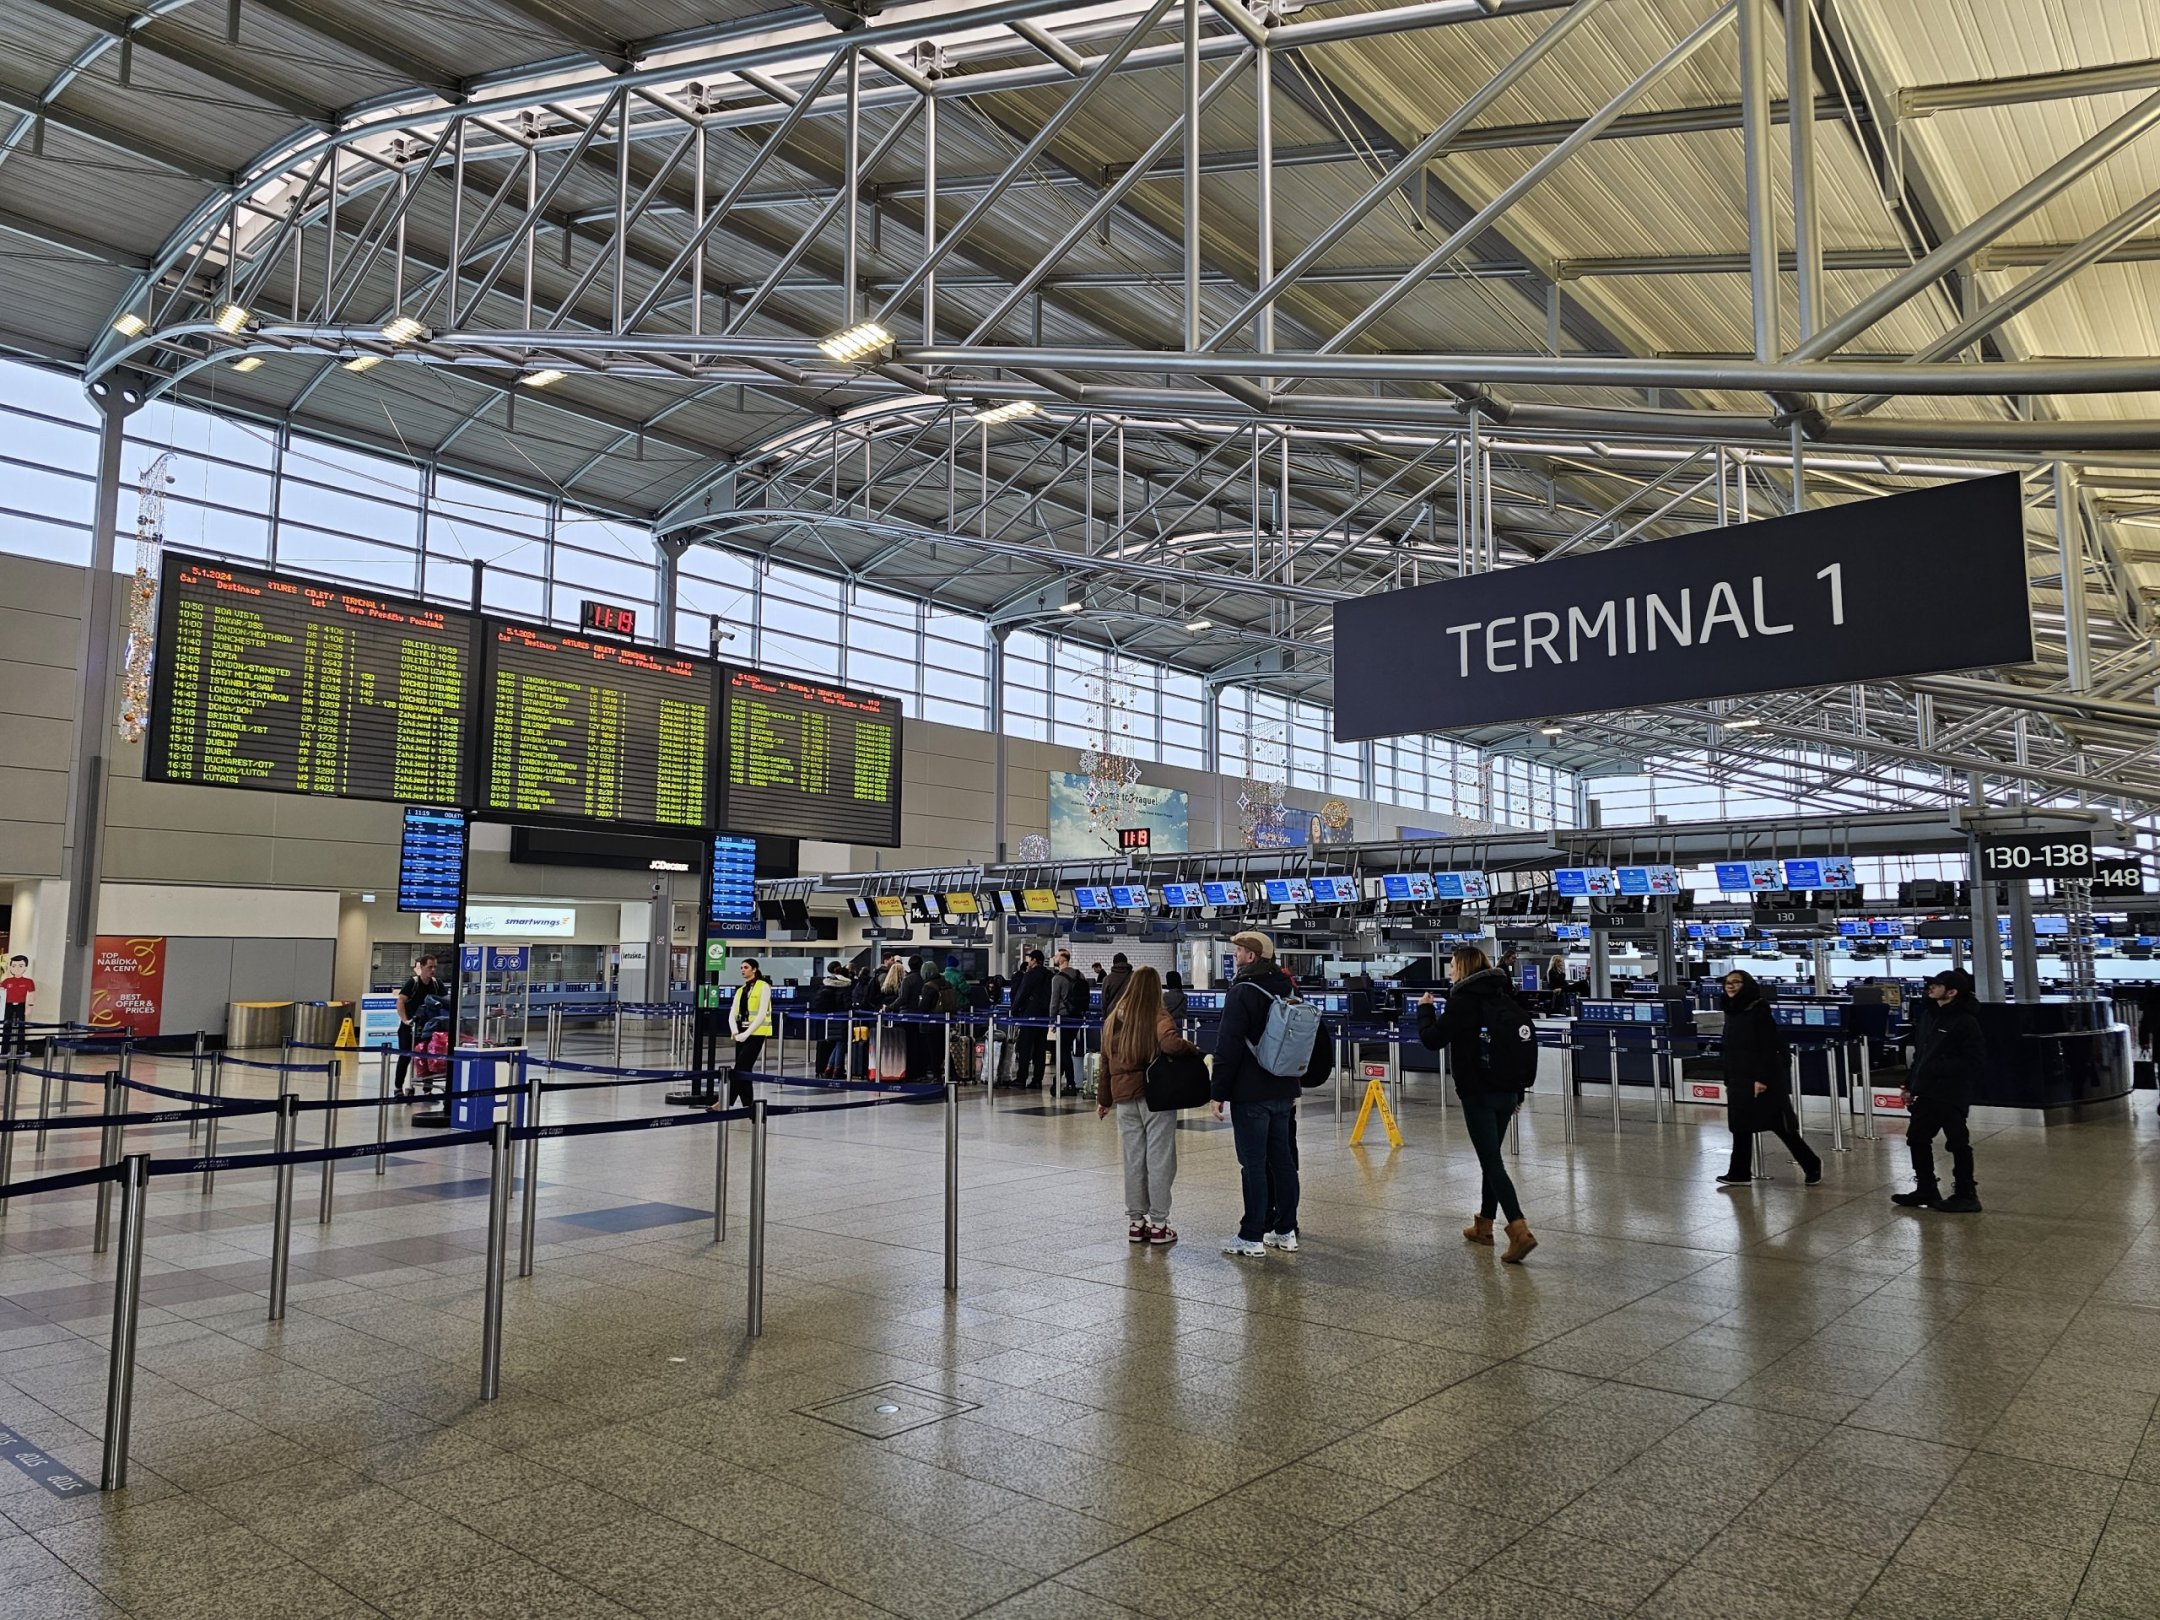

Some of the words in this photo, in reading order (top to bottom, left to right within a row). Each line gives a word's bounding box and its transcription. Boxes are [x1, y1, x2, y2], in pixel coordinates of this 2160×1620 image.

[214, 606, 231, 616] BOA
[234, 609, 260, 620] VISTA
[594, 605, 633, 633] 11:19
[1446, 576, 1794, 678] TERMINAL
[1816, 562, 1845, 626] 1
[214, 615, 263, 630] DAKAR/DSS
[212, 632, 265, 647] MANCHESTER
[213, 624, 292, 643] LONDON/HEATHROW
[212, 641, 243, 652] DUBLIN
[211, 650, 237, 660] SOFIA
[360, 672, 375, 681] 150
[210, 658, 290, 677] LONDON/STANSTED
[359, 680, 374, 689] 142
[209, 676, 273, 691] ISTANBUL/SAW
[210, 667, 232, 677] EAST
[234, 670, 275, 683] MIDLANDS
[359, 688, 374, 697] 140
[208, 684, 289, 702] LONDON/HEATHROW
[208, 693, 266, 708] LONDON/CITY
[207, 702, 252, 714] DOHA/DOH
[206, 711, 243, 722] BRISTOL
[205, 728, 238, 739] TIRANA
[206, 719, 268, 734] ISTANBUL/IST
[205, 737, 237, 748] DUBLIN
[204, 746, 231, 756] DUBAI
[204, 755, 274, 769] BUCHAREST/OTP
[202, 772, 238, 783] KUTAISI
[203, 764, 268, 777] LONDON/LUTON
[1124, 830, 1147, 846] 11:19
[1985, 844, 2089, 869] 130-138
[649, 860, 689, 871] JCDecaux
[505, 918, 560, 927] smartwings
[1304, 920, 1316, 928] 133
[1428, 919, 1441, 927] 132
[1610, 917, 1625, 925] 131
[1777, 912, 1795, 922] 130
[97, 957, 138, 965] NABÍDKA
[115, 1000, 146, 1008] OFFER
[125, 1006, 155, 1014] PRICES
[15, 1453, 49, 1467] STOP
[47, 1475, 83, 1491] STOP
